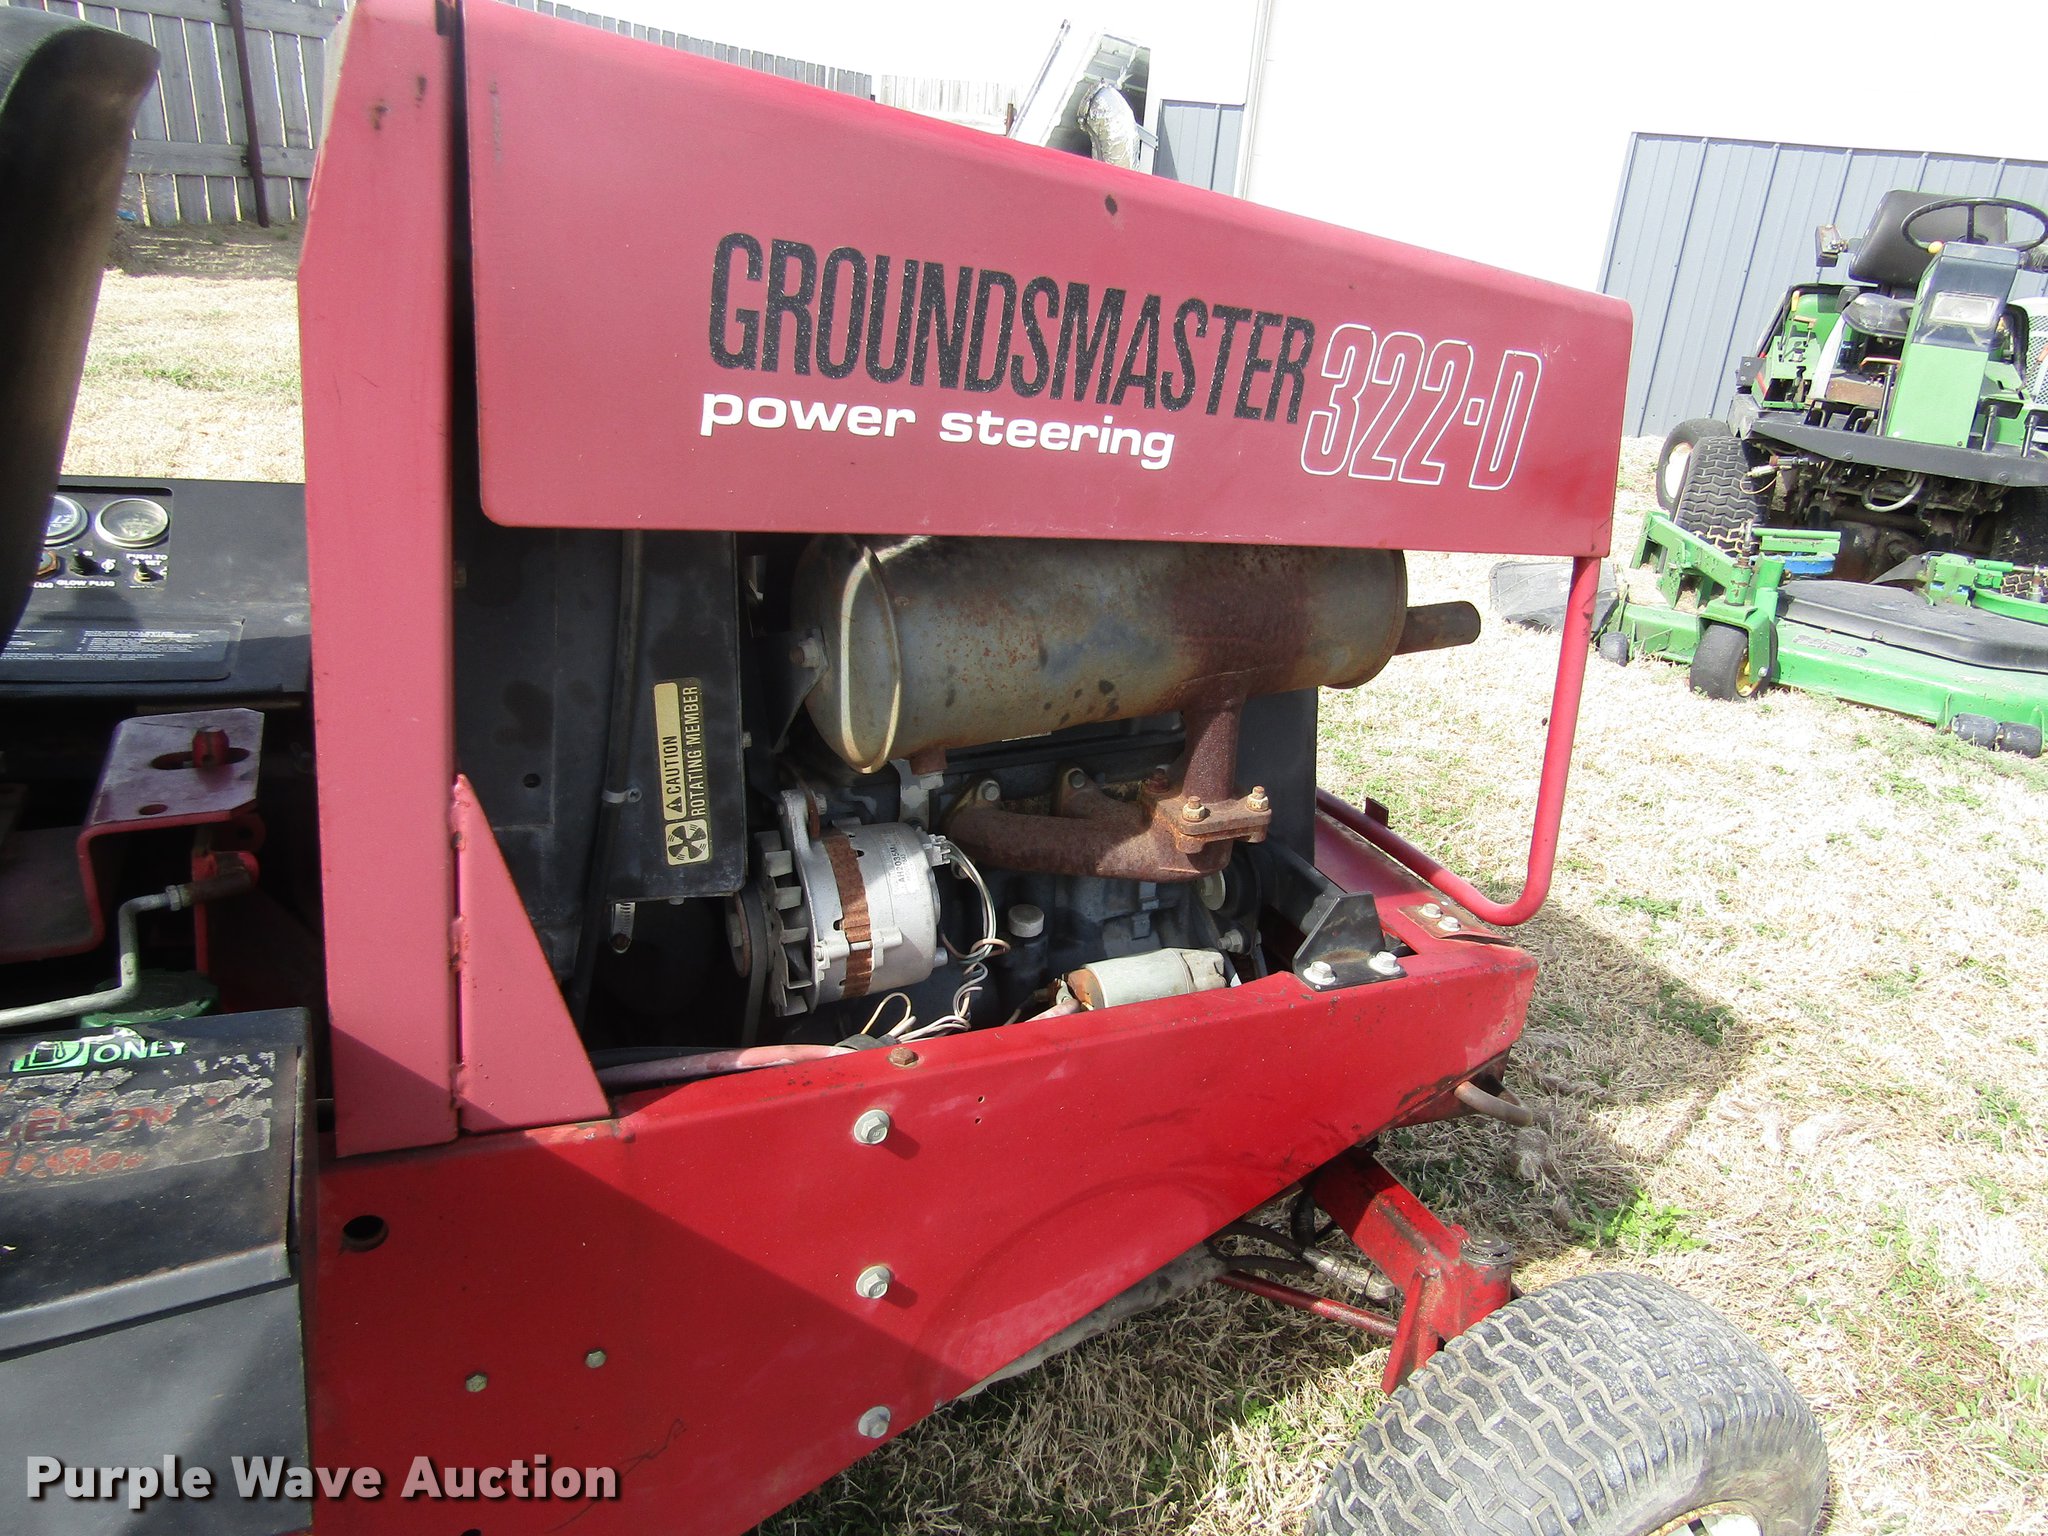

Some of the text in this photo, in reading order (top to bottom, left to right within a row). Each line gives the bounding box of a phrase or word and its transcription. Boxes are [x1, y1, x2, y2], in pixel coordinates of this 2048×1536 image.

[709, 233, 1543, 490] GROUNDSMASTER 322-D
[700, 392, 1176, 472] power steering
[33, 581, 54, 589] LUG
[663, 735, 681, 795] CAUTION
[683, 686, 706, 817] ROTATING MEMBER
[93, 1041, 187, 1063] ONLY
